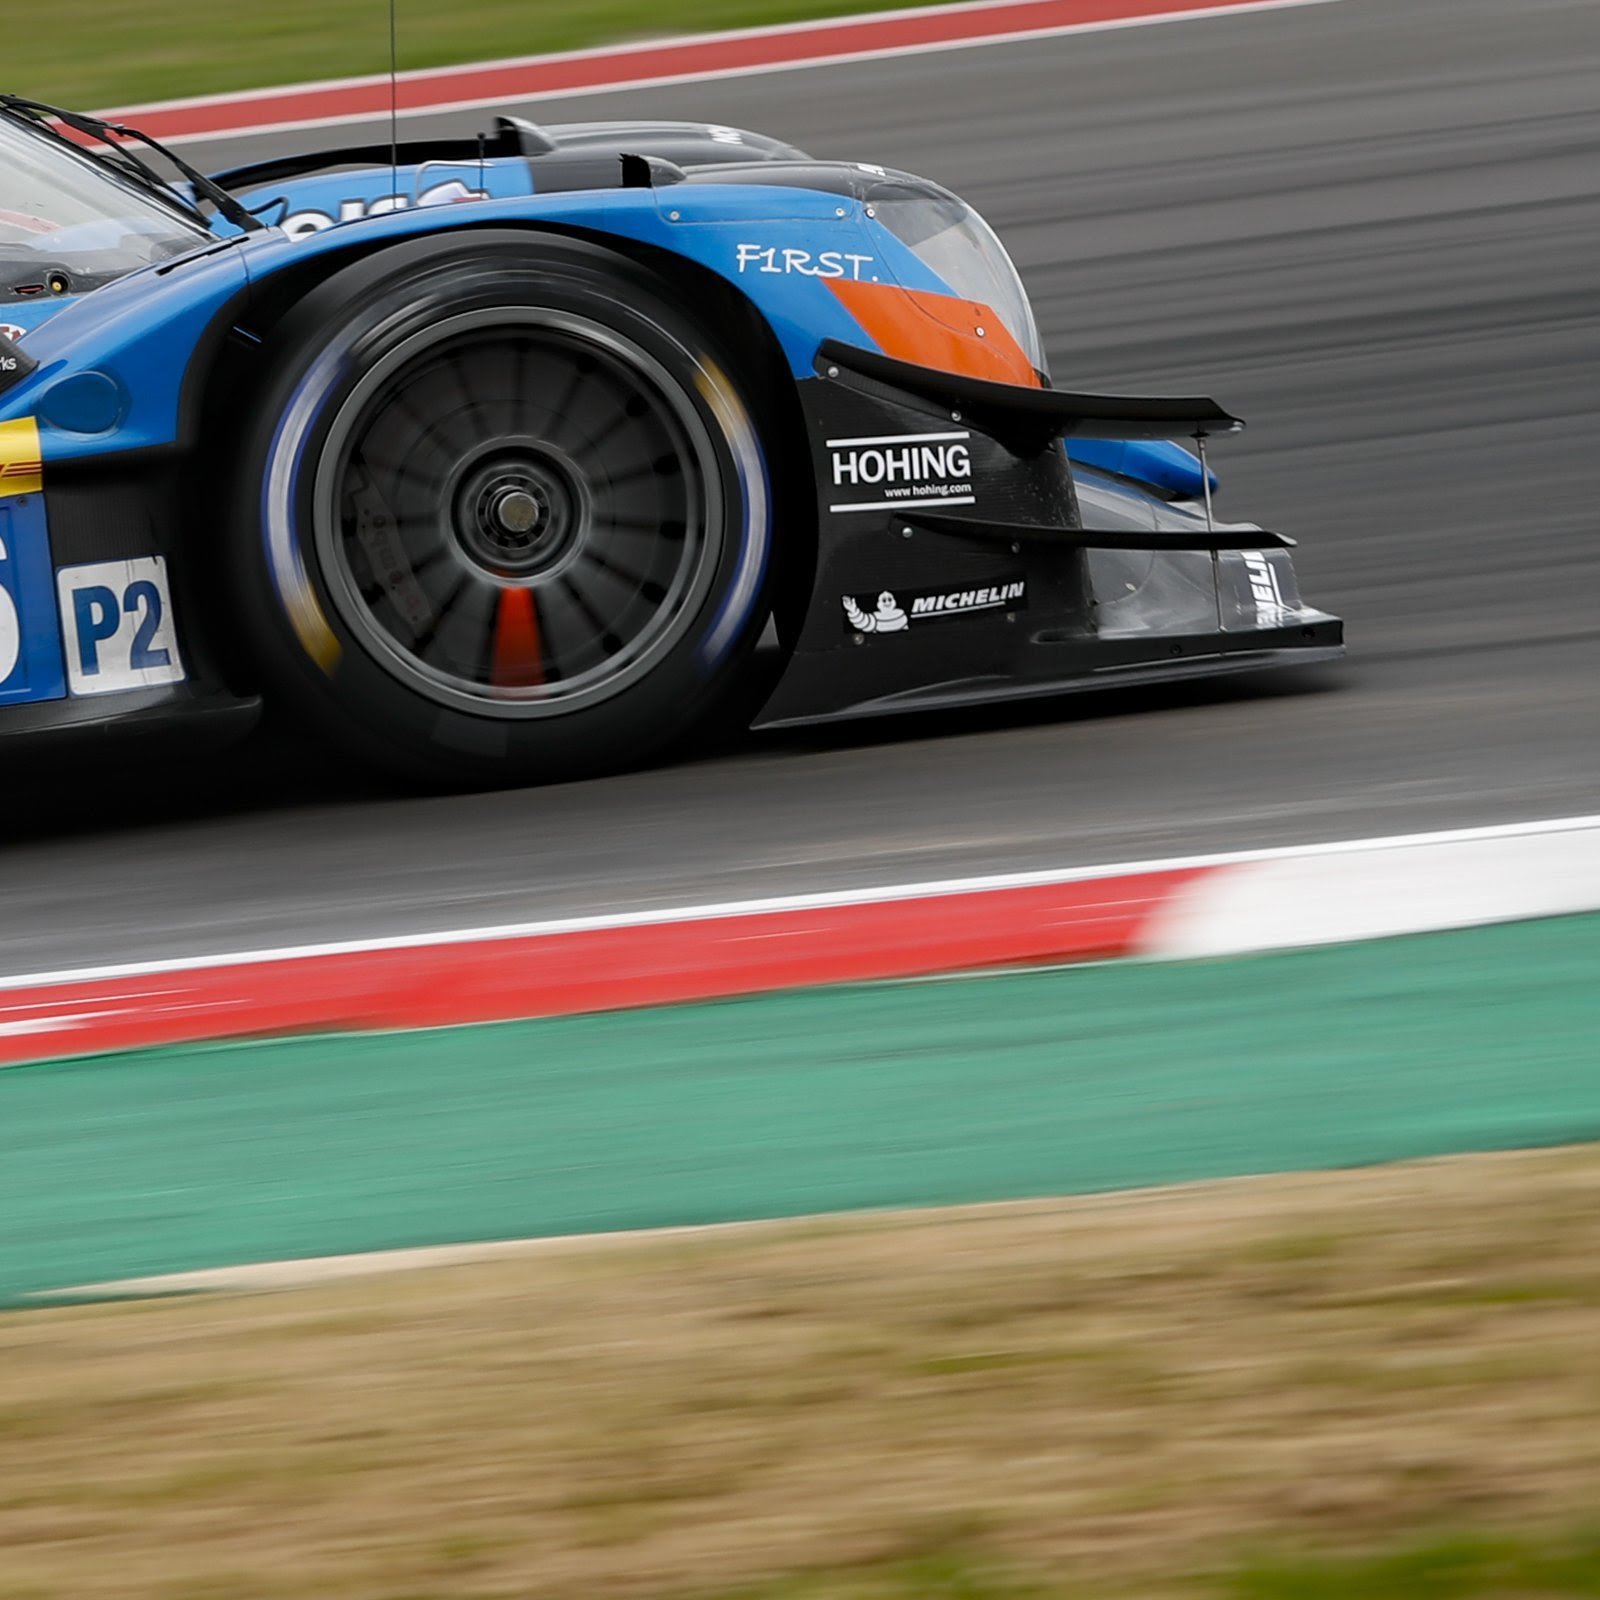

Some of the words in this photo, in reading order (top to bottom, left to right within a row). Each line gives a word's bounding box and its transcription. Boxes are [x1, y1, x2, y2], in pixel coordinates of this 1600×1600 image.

[832, 444, 972, 485] HOHING
[911, 581, 1025, 613] MICHELIN
[71, 580, 172, 677] P2
